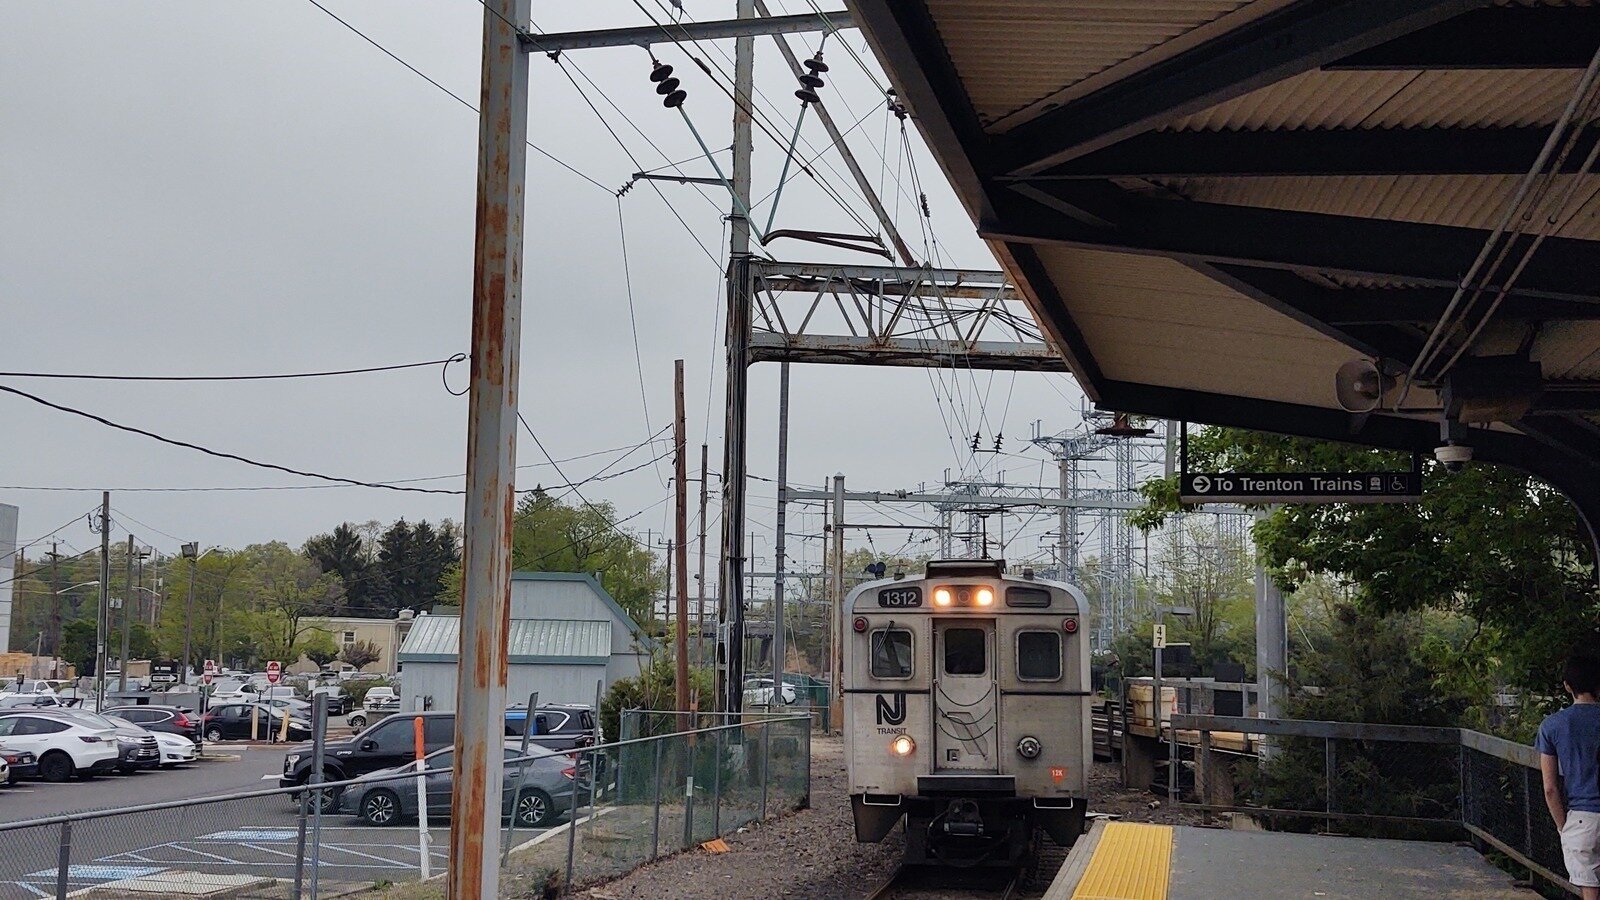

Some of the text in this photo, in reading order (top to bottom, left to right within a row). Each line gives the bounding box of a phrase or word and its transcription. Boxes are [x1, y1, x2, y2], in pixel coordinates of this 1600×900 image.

[1213, 477, 1363, 492] To Trenton Trains
[883, 591, 918, 605] 1312
[876, 691, 907, 726] NJ
[876, 727, 907, 735] TRANSIT
